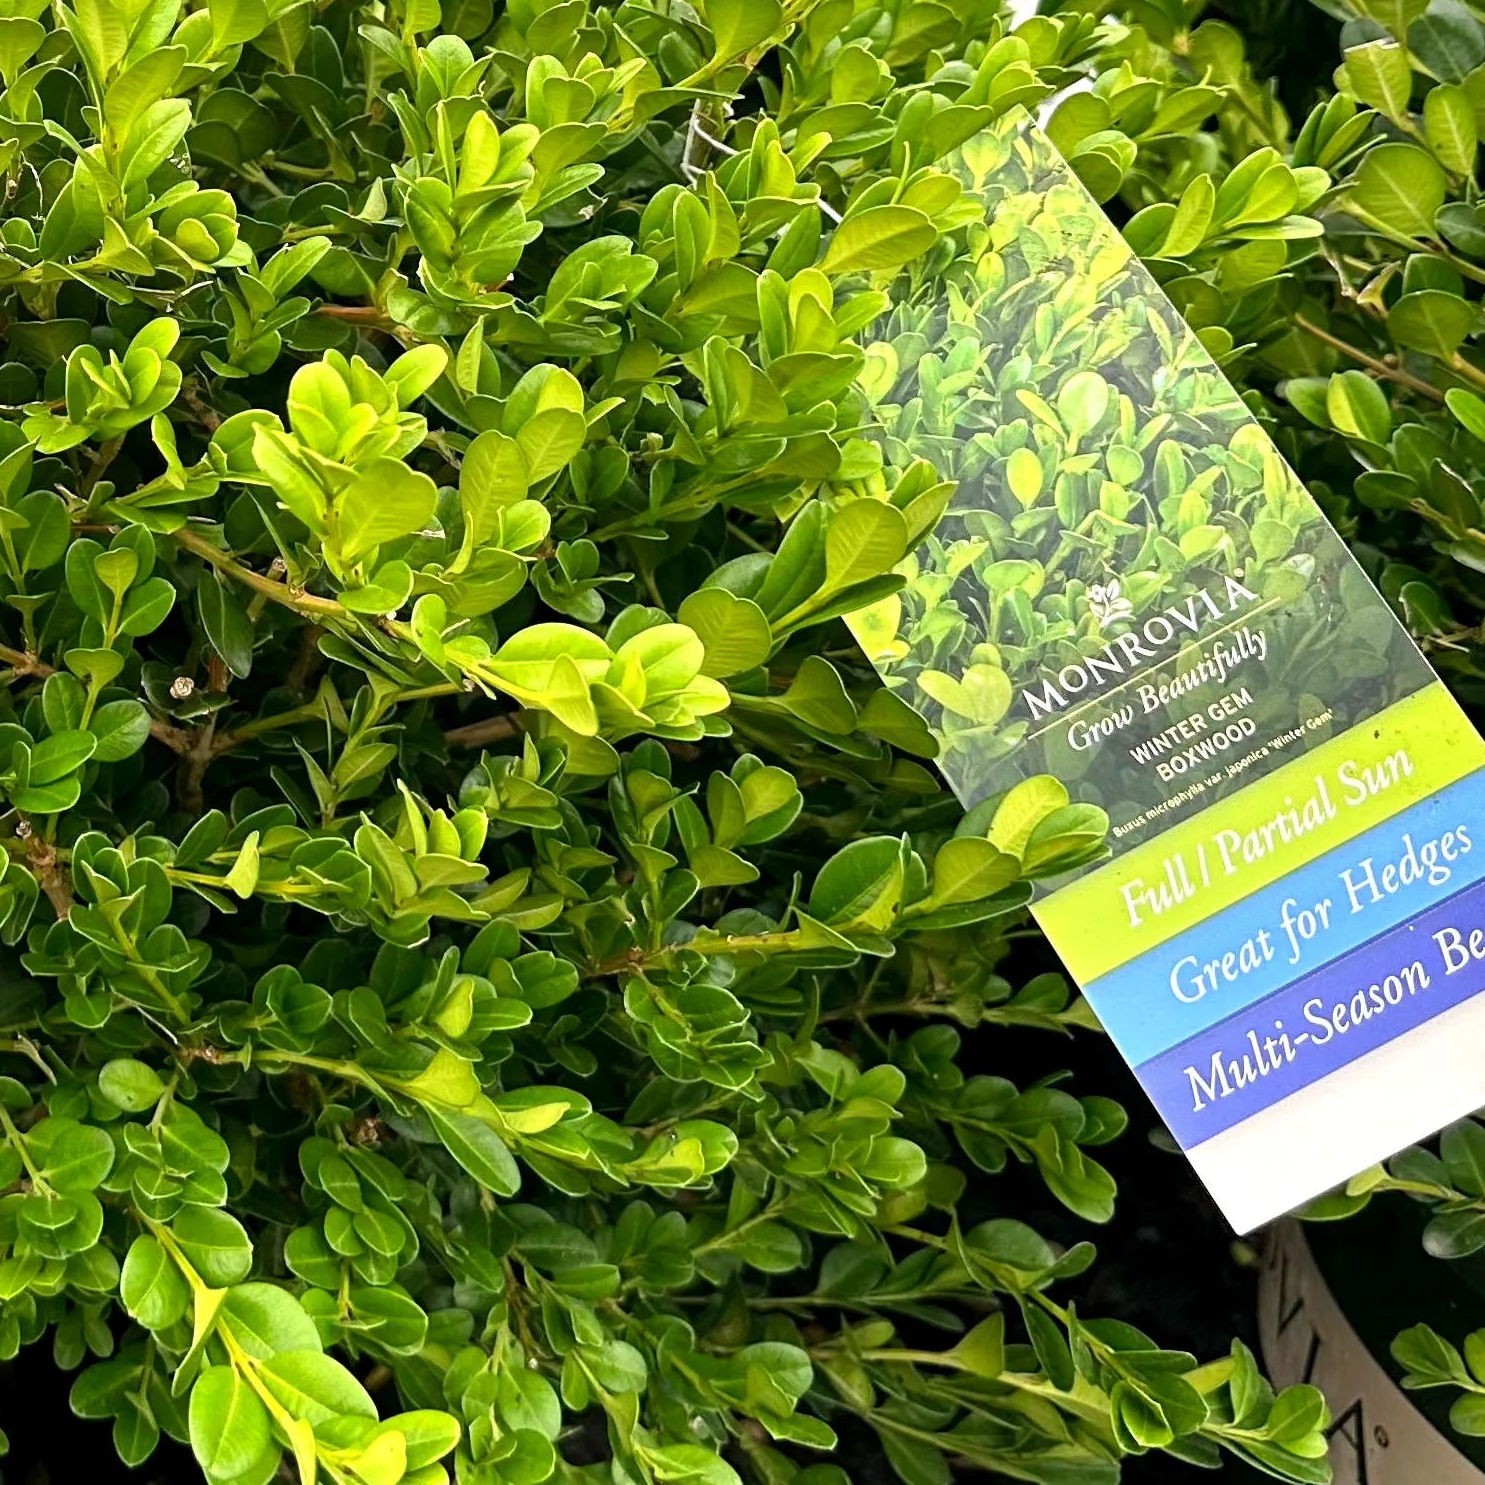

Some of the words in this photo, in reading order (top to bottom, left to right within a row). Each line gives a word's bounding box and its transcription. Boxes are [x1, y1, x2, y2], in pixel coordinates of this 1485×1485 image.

[1021, 575, 1259, 721] MONROVIA
[1067, 705, 1134, 751] Grow
[1136, 626, 1267, 714] Beautifully
[1112, 815, 1147, 839] Buxus
[1145, 782, 1205, 820] microphylla
[1204, 771, 1226, 788] var.
[1224, 747, 1270, 779] japonica
[1129, 714, 1208, 765] WINTER
[1207, 687, 1254, 722] GEM
[1155, 717, 1256, 782] BOXWOOD
[1118, 852, 1195, 928] Full
[1197, 843, 1211, 888] /
[1212, 775, 1336, 875] Partial
[1337, 748, 1414, 806] Sun
[1169, 928, 1275, 1004] Great
[1279, 897, 1332, 965] for
[1338, 824, 1472, 914] Hedges
[1183, 960, 1430, 1113] Multi-Season
